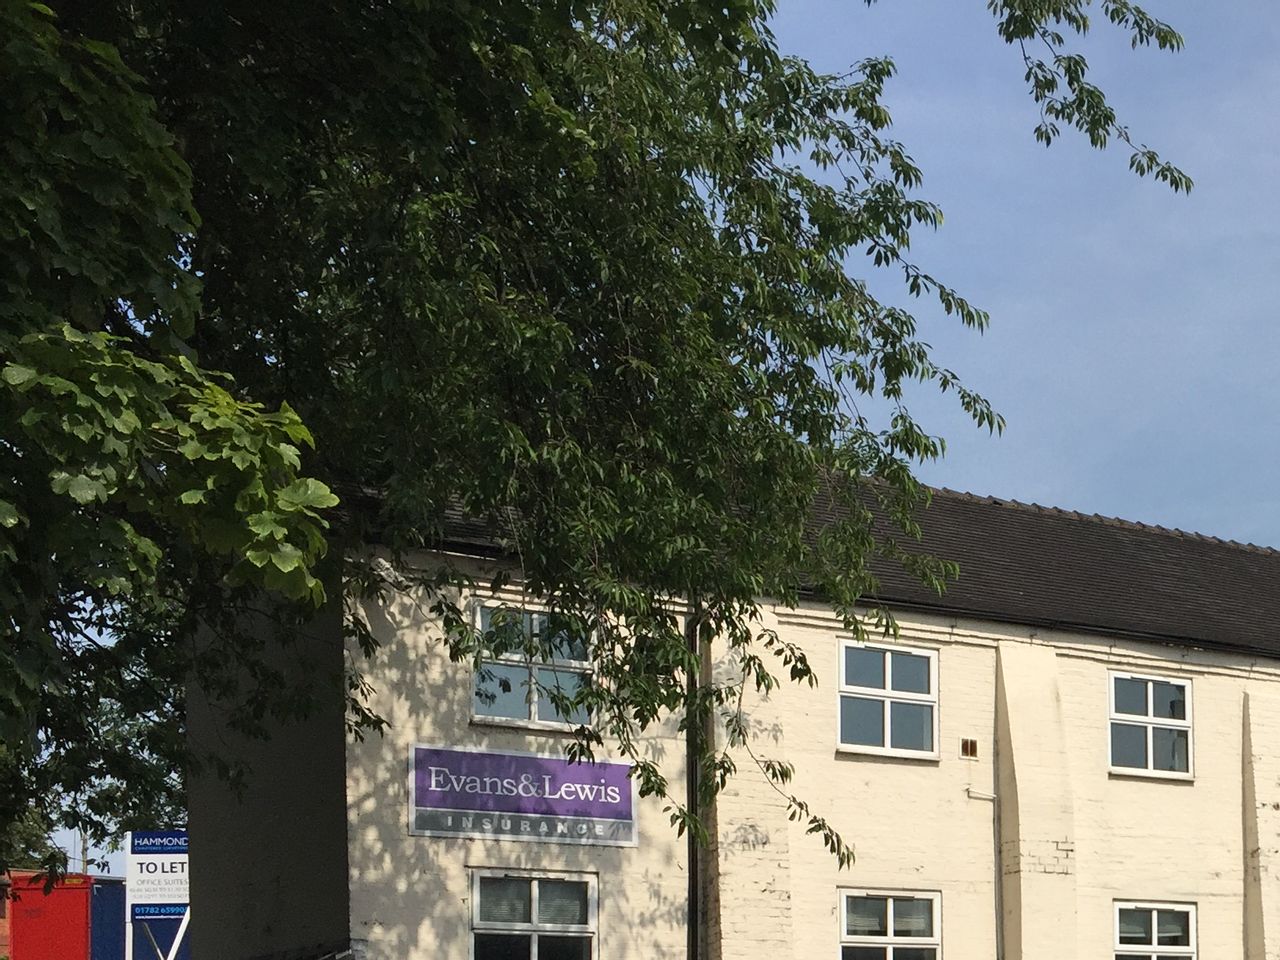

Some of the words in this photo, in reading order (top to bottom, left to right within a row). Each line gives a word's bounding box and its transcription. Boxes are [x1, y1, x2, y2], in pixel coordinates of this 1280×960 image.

[428, 766, 621, 803] Evans&Lewis
[447, 815, 604, 836] INSURANCE
[137, 862, 158, 873] TO
[161, 862, 187, 873] LET
